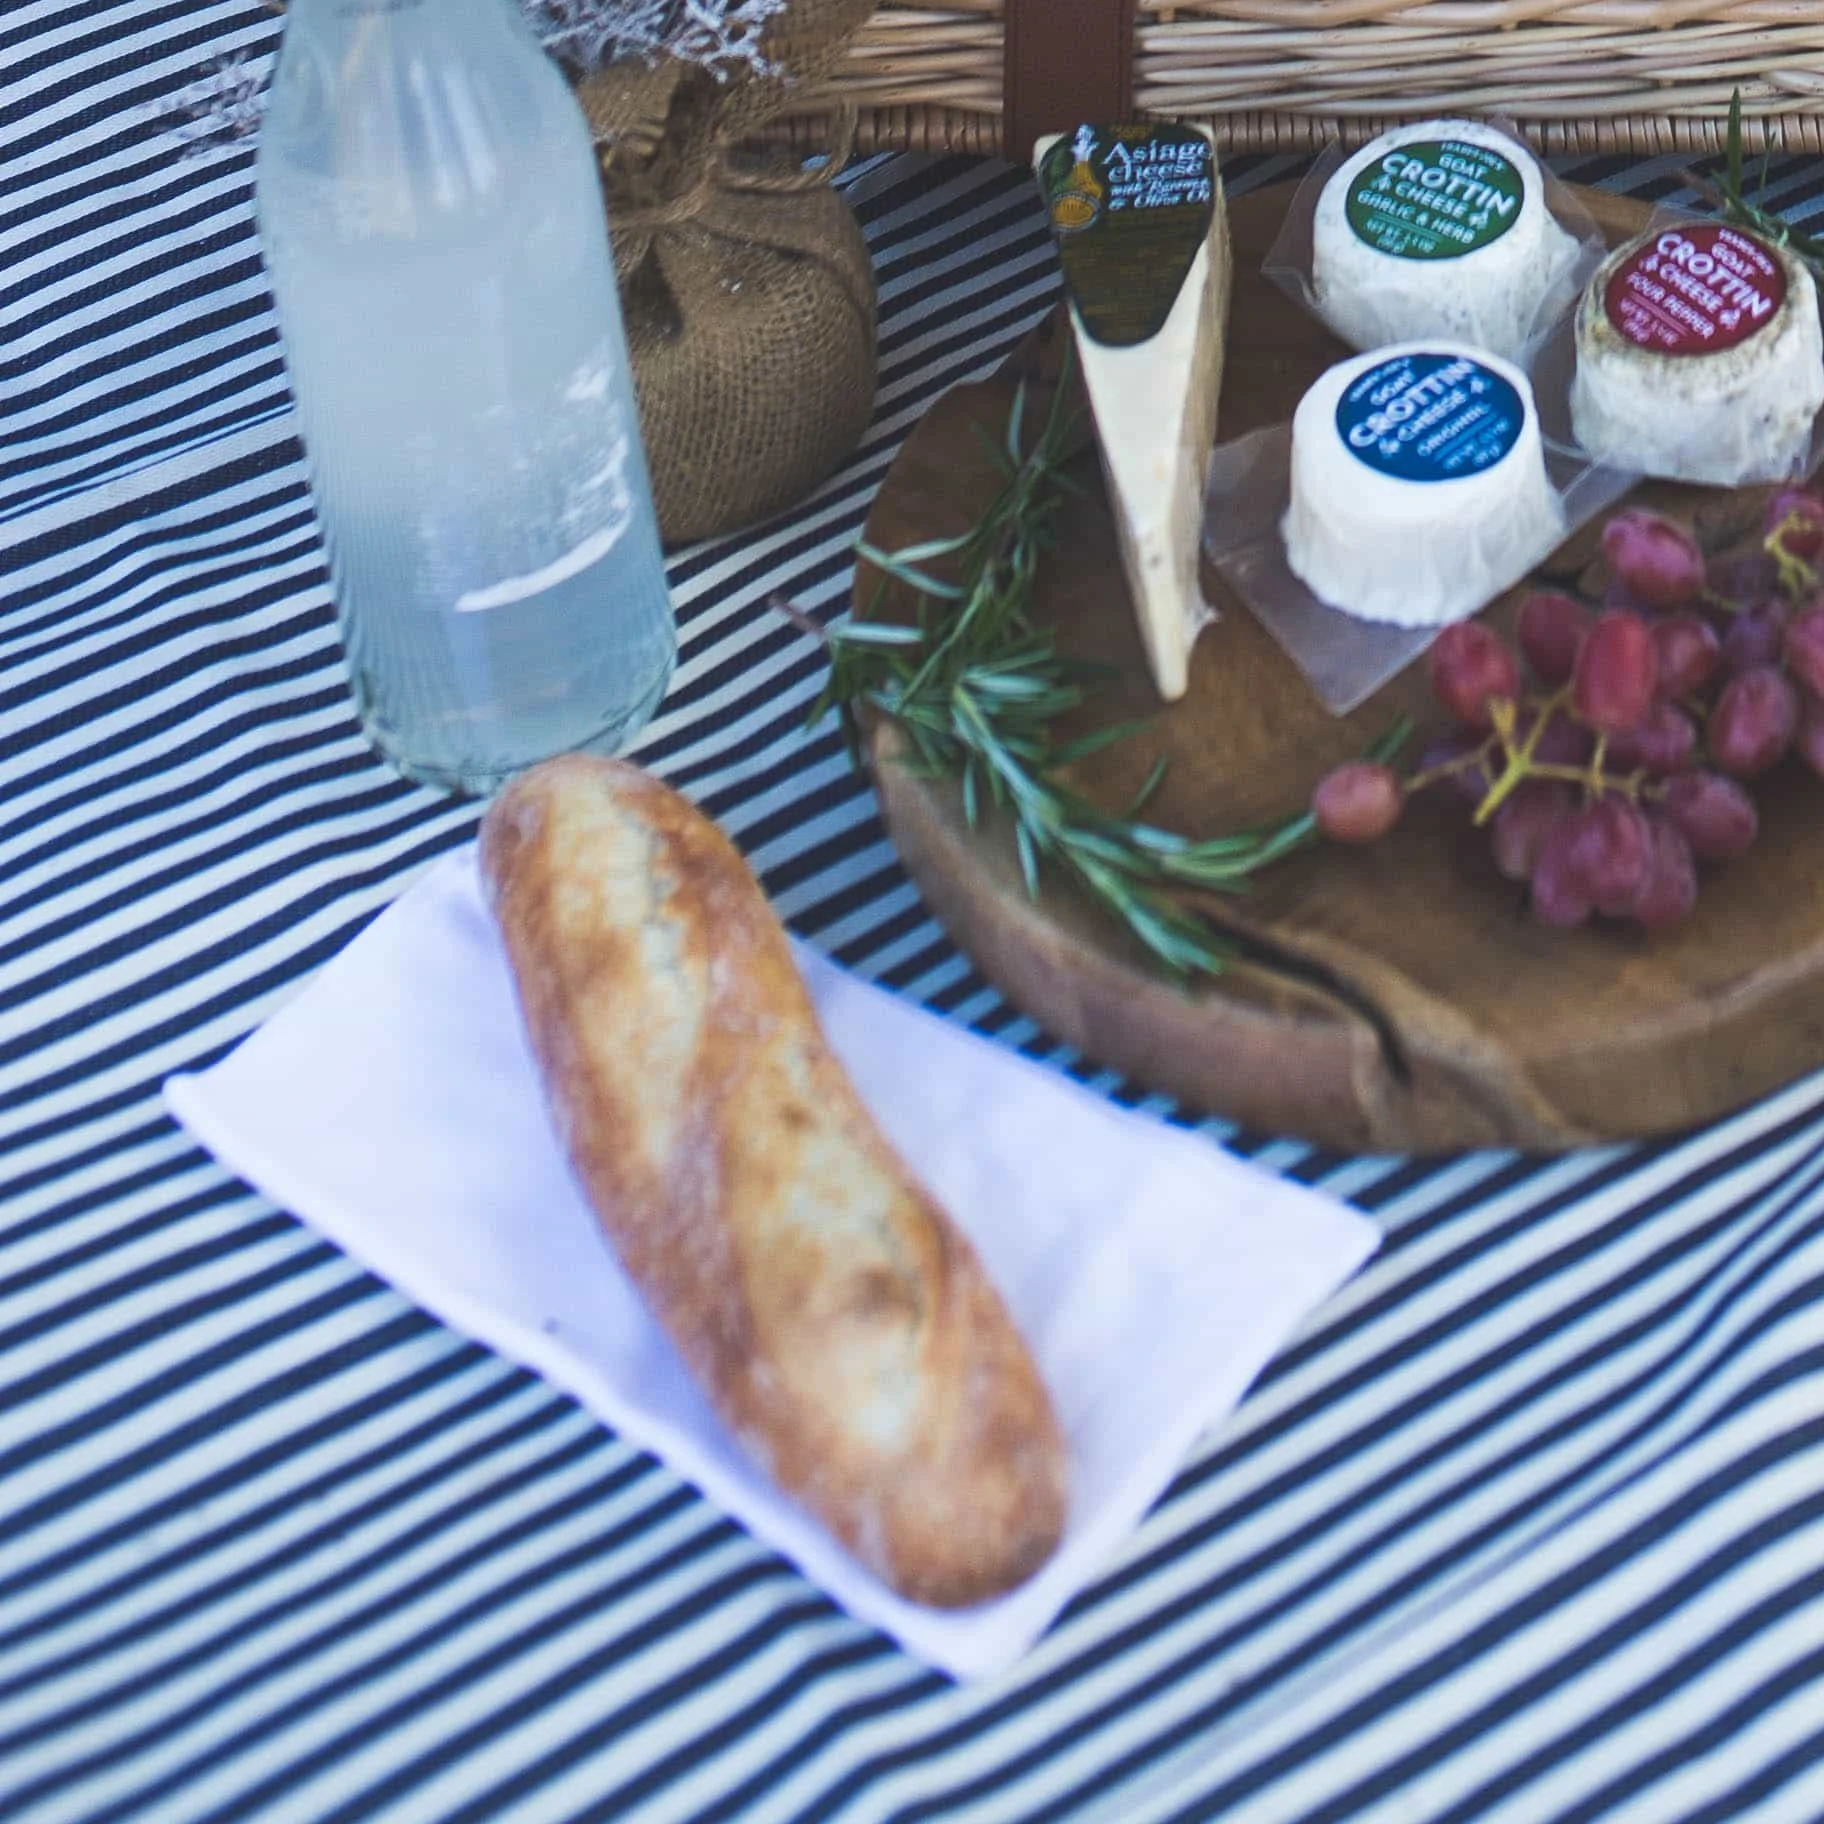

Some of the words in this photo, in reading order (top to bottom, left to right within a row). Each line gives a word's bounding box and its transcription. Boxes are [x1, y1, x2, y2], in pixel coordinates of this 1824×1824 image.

[1101, 138, 1214, 165] Asiago
[1108, 159, 1203, 183] cheese
[1439, 153, 1489, 181] GOAT
[1382, 154, 1516, 219] CROTTIN
[1395, 181, 1469, 220] CHEESE
[1357, 189, 1416, 221] GARLIC
[1431, 217, 1476, 245] HERB
[1657, 234, 1773, 320] CROTTIN
[1712, 242, 1757, 279] GOAT
[1626, 271, 1667, 303] FOUR
[1662, 294, 1716, 340] PEPPER
[1660, 262, 1725, 314] CHEESE
[1349, 357, 1476, 447] CROTTIN
[1370, 369, 1416, 406] GOAT
[1398, 386, 1469, 442] CHEESE
